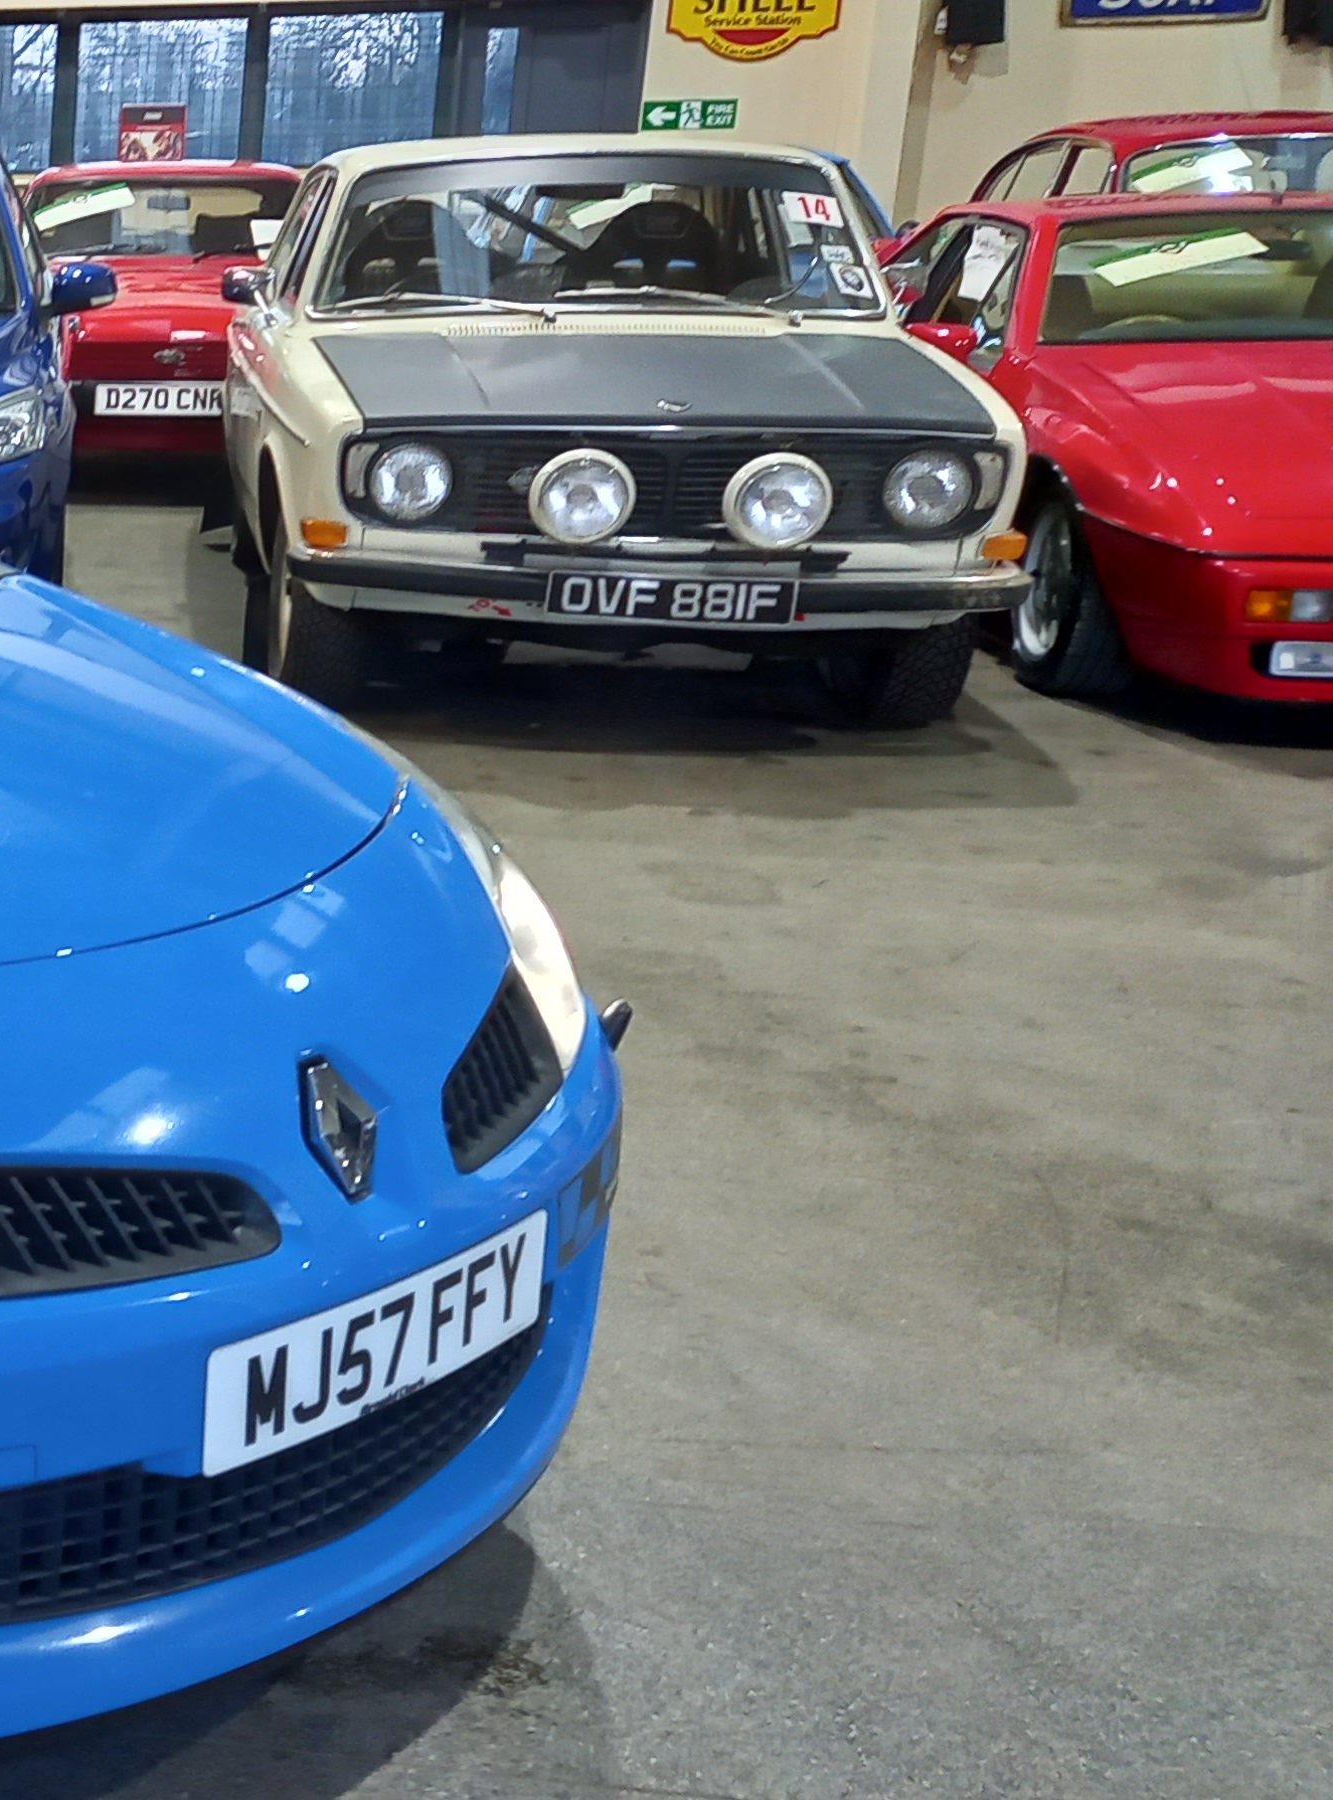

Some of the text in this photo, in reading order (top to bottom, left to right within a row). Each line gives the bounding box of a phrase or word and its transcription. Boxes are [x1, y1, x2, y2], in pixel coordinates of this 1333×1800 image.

[704, 13, 802, 28] Service Station
[705, 114, 733, 126] EXIT
[706, 103, 735, 115] FIRE
[797, 196, 831, 221] 14
[105, 387, 170, 411] D270
[560, 576, 782, 620] OVF 881F
[243, 1231, 527, 1447] MJ57 FFY
